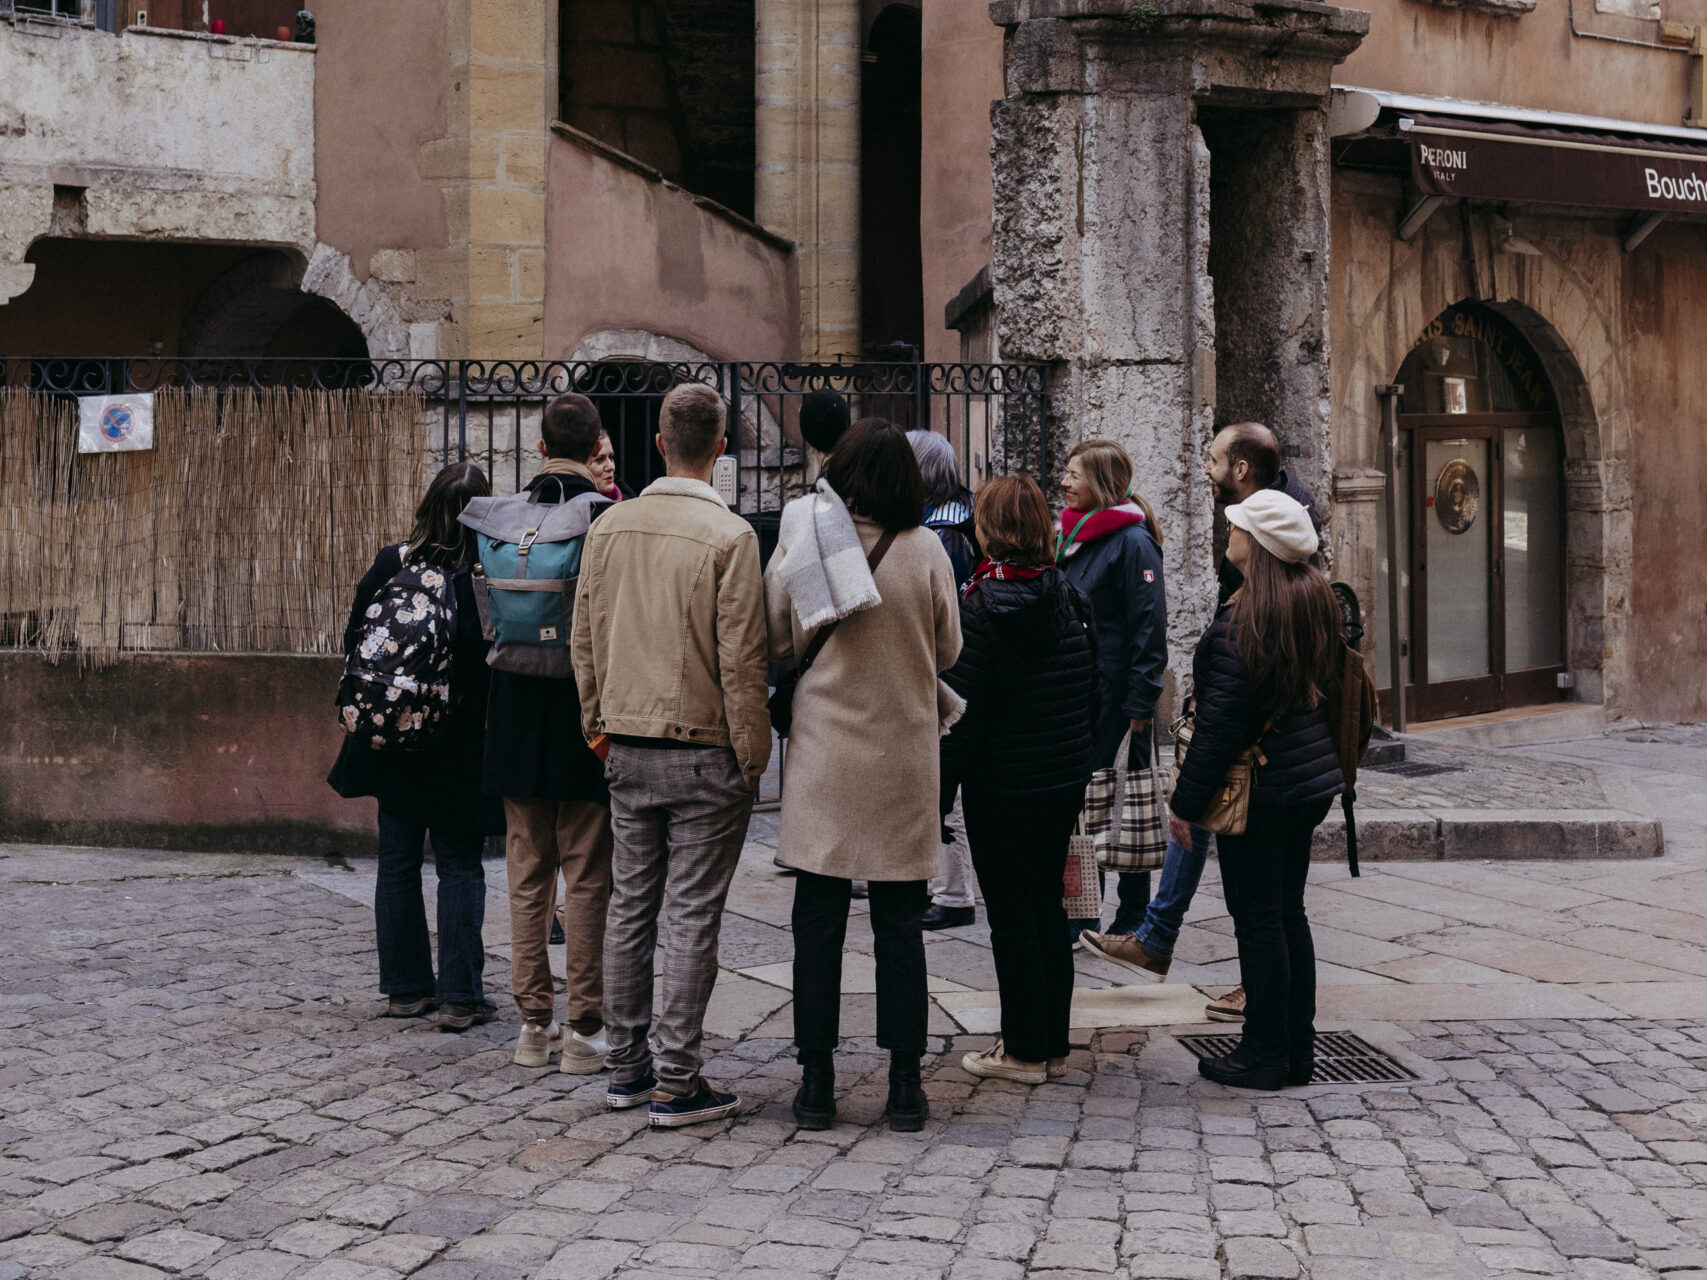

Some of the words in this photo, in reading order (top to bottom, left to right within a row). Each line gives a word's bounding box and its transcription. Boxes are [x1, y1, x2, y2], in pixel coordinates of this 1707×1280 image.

[1420, 144, 1467, 169] PERONI
[1433, 170, 1456, 181] ITALY
[1645, 168, 1707, 202] Bouch
[1453, 312, 1507, 353] SAINT
